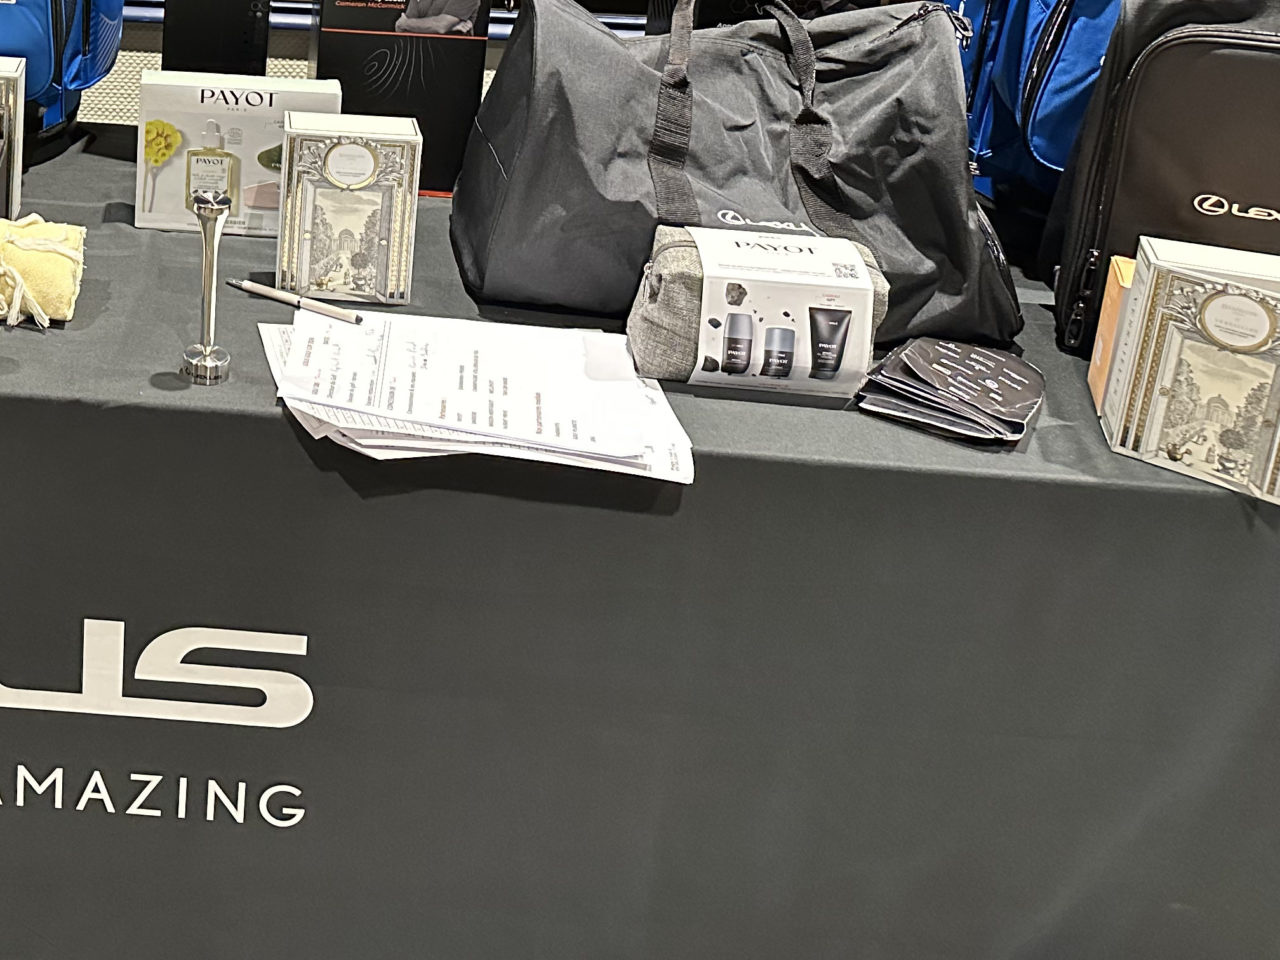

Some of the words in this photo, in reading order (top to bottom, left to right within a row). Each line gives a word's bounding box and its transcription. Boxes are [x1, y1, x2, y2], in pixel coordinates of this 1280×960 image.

[200, 89, 279, 107] PAYOT
[196, 157, 225, 165] PAYOT
[734, 241, 818, 255] PAYOT
